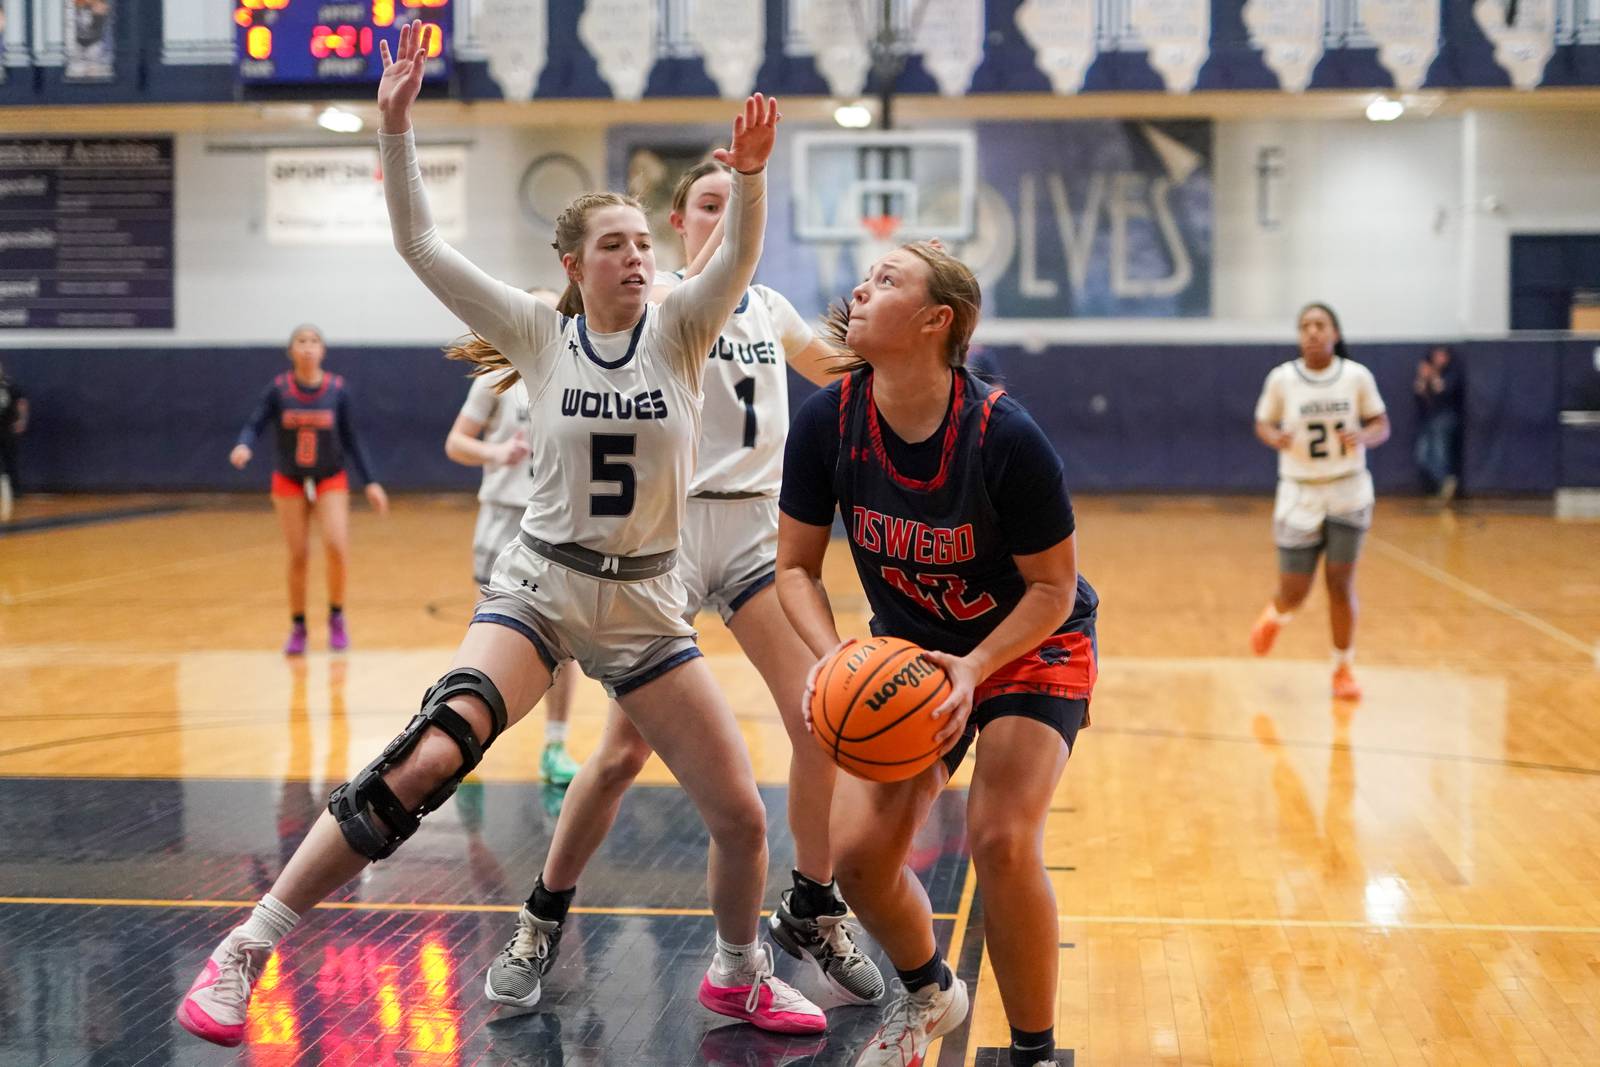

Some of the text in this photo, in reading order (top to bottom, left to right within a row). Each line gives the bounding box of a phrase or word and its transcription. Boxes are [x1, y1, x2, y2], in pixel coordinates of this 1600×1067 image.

[561, 388, 668, 419] WOLVES
[734, 377, 758, 448] 1
[589, 432, 637, 517] 5
[853, 505, 976, 565] OSWEGO
[864, 653, 937, 712] Wilson
